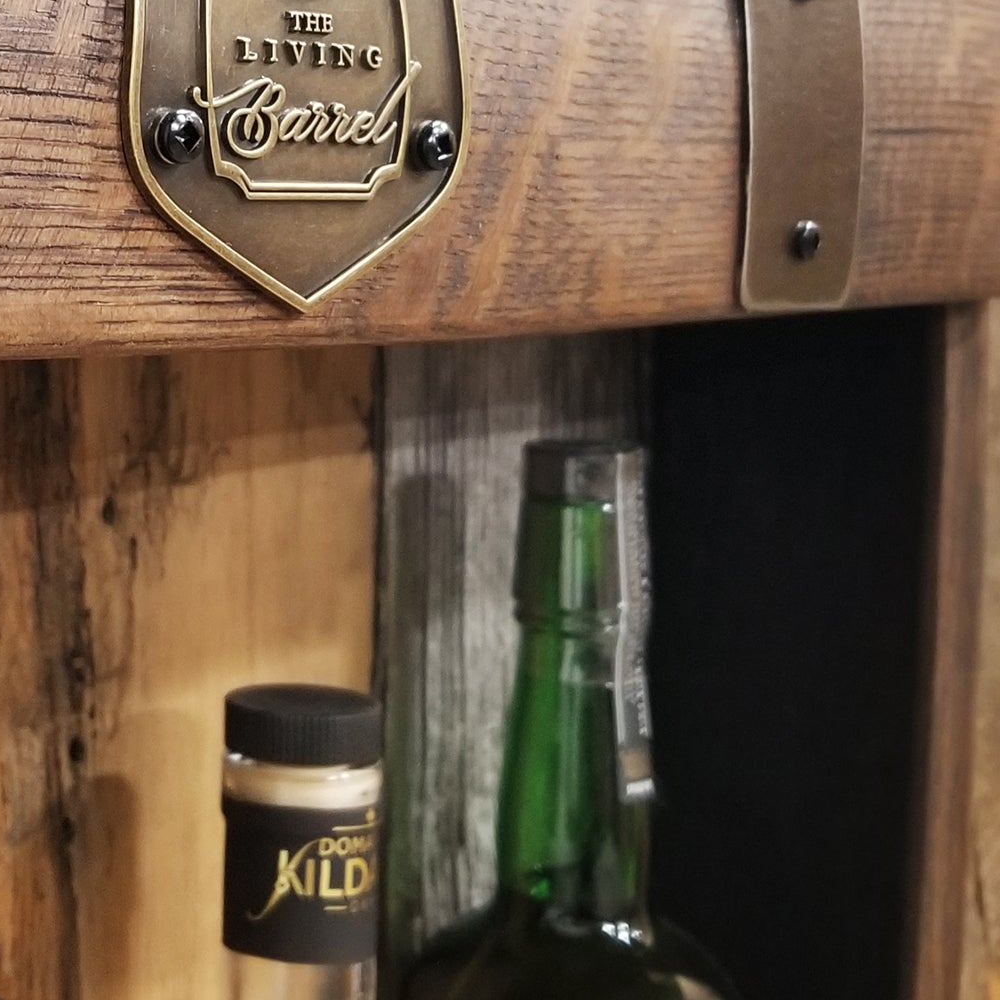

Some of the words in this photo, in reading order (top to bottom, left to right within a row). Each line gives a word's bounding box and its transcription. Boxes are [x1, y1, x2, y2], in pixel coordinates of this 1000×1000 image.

[286, 9, 335, 34] THE
[236, 35, 384, 69] LIVING
[192, 59, 423, 160] Barrel
